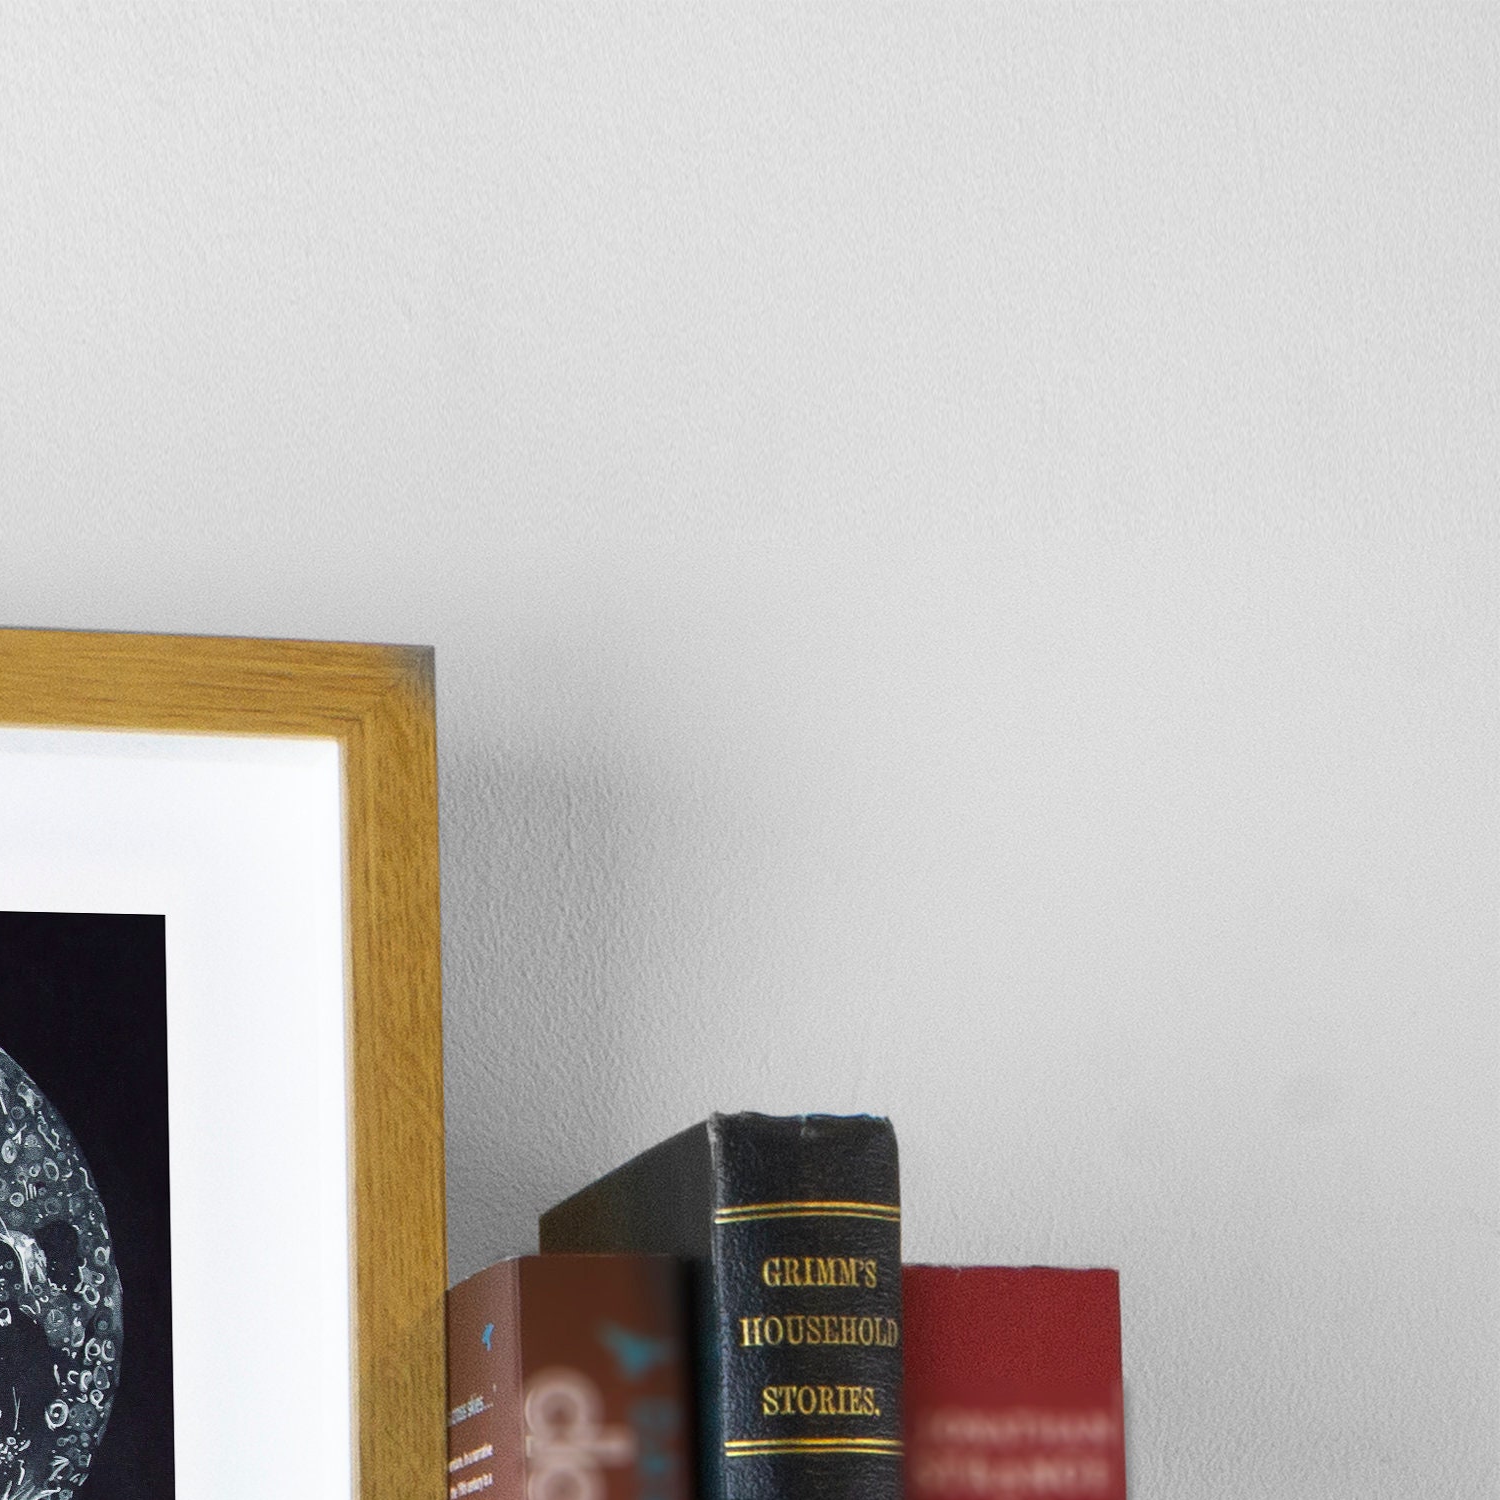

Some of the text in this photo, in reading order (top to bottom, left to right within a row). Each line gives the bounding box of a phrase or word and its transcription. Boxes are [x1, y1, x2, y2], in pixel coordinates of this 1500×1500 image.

[762, 1256, 878, 1288] GRIMM'S
[739, 1315, 899, 1347] HOUSEHOLD
[762, 1385, 882, 1417] STORIES.
